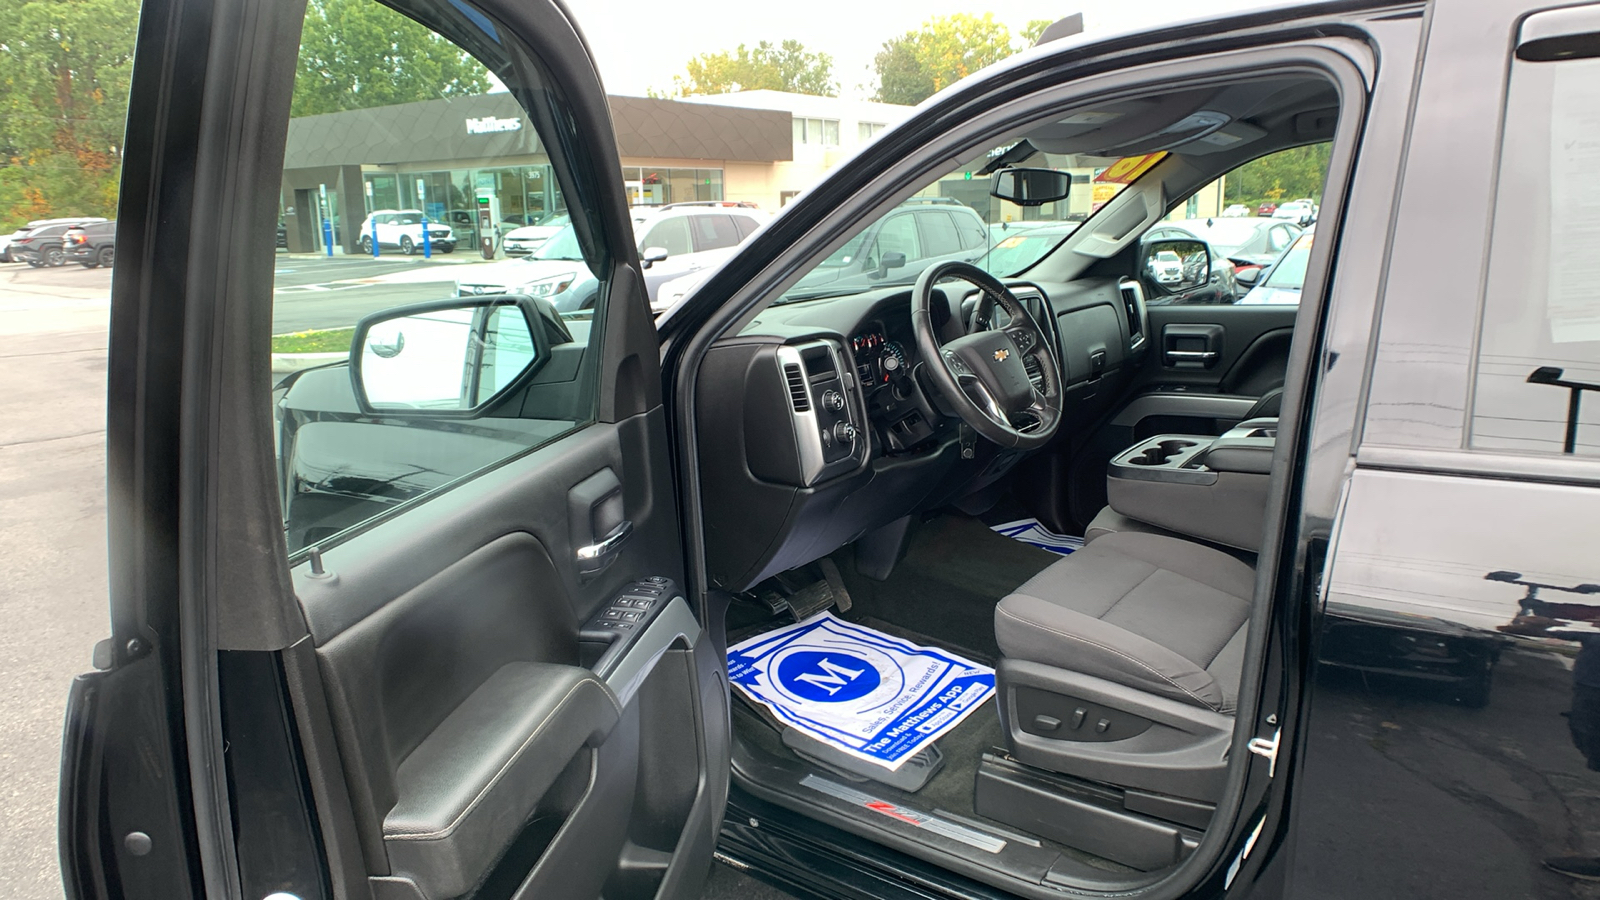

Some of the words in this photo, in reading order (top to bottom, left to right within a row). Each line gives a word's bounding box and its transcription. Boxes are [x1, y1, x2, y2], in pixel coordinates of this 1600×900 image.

[466, 116, 521, 134] Matthews
[793, 657, 866, 697] M
[862, 716, 890, 734] Sales,
[883, 694, 915, 715] Service,
[909, 661, 941, 693] Rewards!
[863, 737, 892, 753] The
[886, 702, 943, 738] Matthews
[938, 685, 963, 704] App
